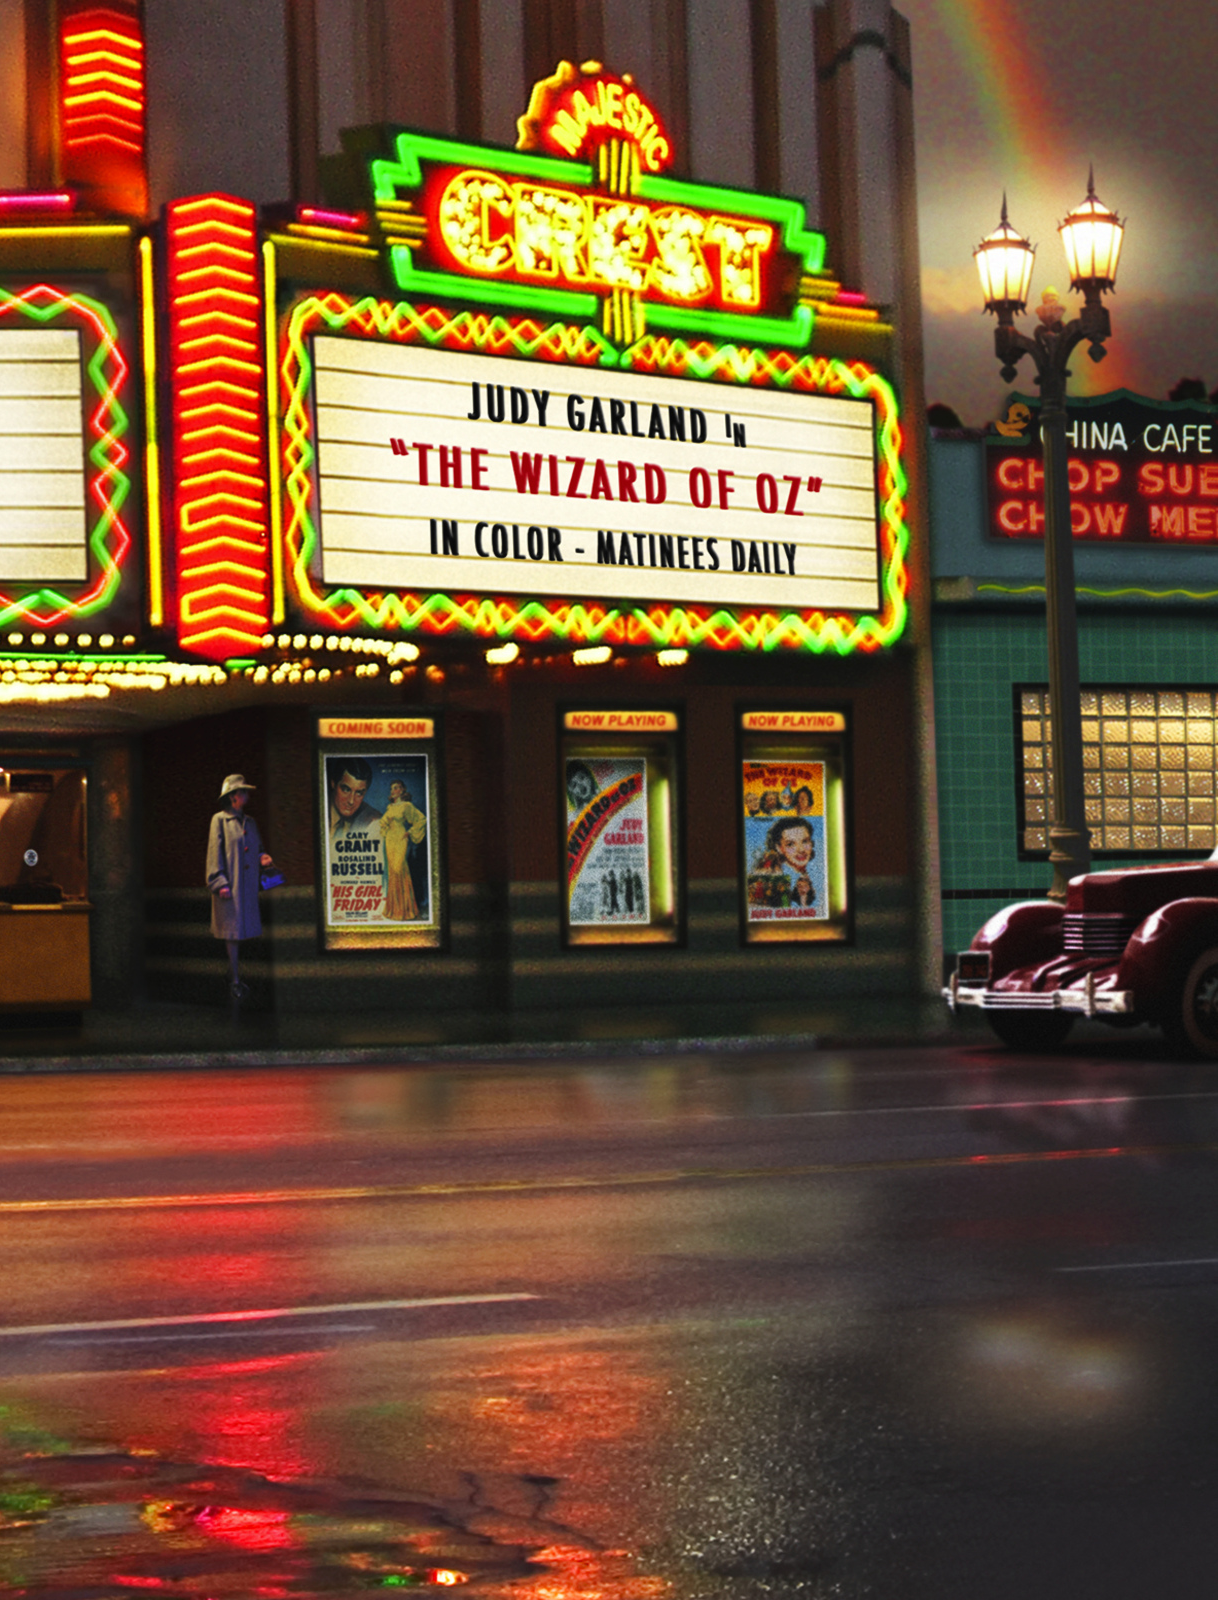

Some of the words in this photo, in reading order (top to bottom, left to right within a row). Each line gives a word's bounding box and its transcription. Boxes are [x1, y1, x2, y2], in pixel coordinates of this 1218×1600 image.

[549, 80, 669, 171] MAJESTIC
[439, 168, 772, 307] CREST
[467, 381, 551, 427] JUDY
[567, 394, 708, 444] GARLAND
[1143, 423, 1213, 453] CAFE
[389, 438, 490, 491] "THE
[510, 451, 667, 505] WIZARD
[689, 466, 735, 510] OF
[756, 472, 823, 516] OZ"
[997, 458, 1121, 493] CHOP
[998, 501, 1129, 535] CHOW
[429, 518, 460, 557] IN
[474, 521, 564, 562] COLOR
[597, 530, 721, 571] MATINEES
[731, 539, 797, 576] DAILY
[571, 714, 605, 726] NOW
[608, 714, 667, 726] PLAYING
[748, 715, 780, 727] NOW
[782, 715, 835, 727] PLAYING
[328, 722, 383, 735] COMING
[387, 722, 427, 735] SOON
[346, 832, 369, 840] CARY
[604, 832, 645, 846] GARLAND
[335, 839, 381, 853] GRANT
[331, 862, 384, 876] RUSSELL
[354, 884, 384, 898] GIRL
[750, 909, 773, 919] JUDY
[775, 908, 817, 918] GARLAND
